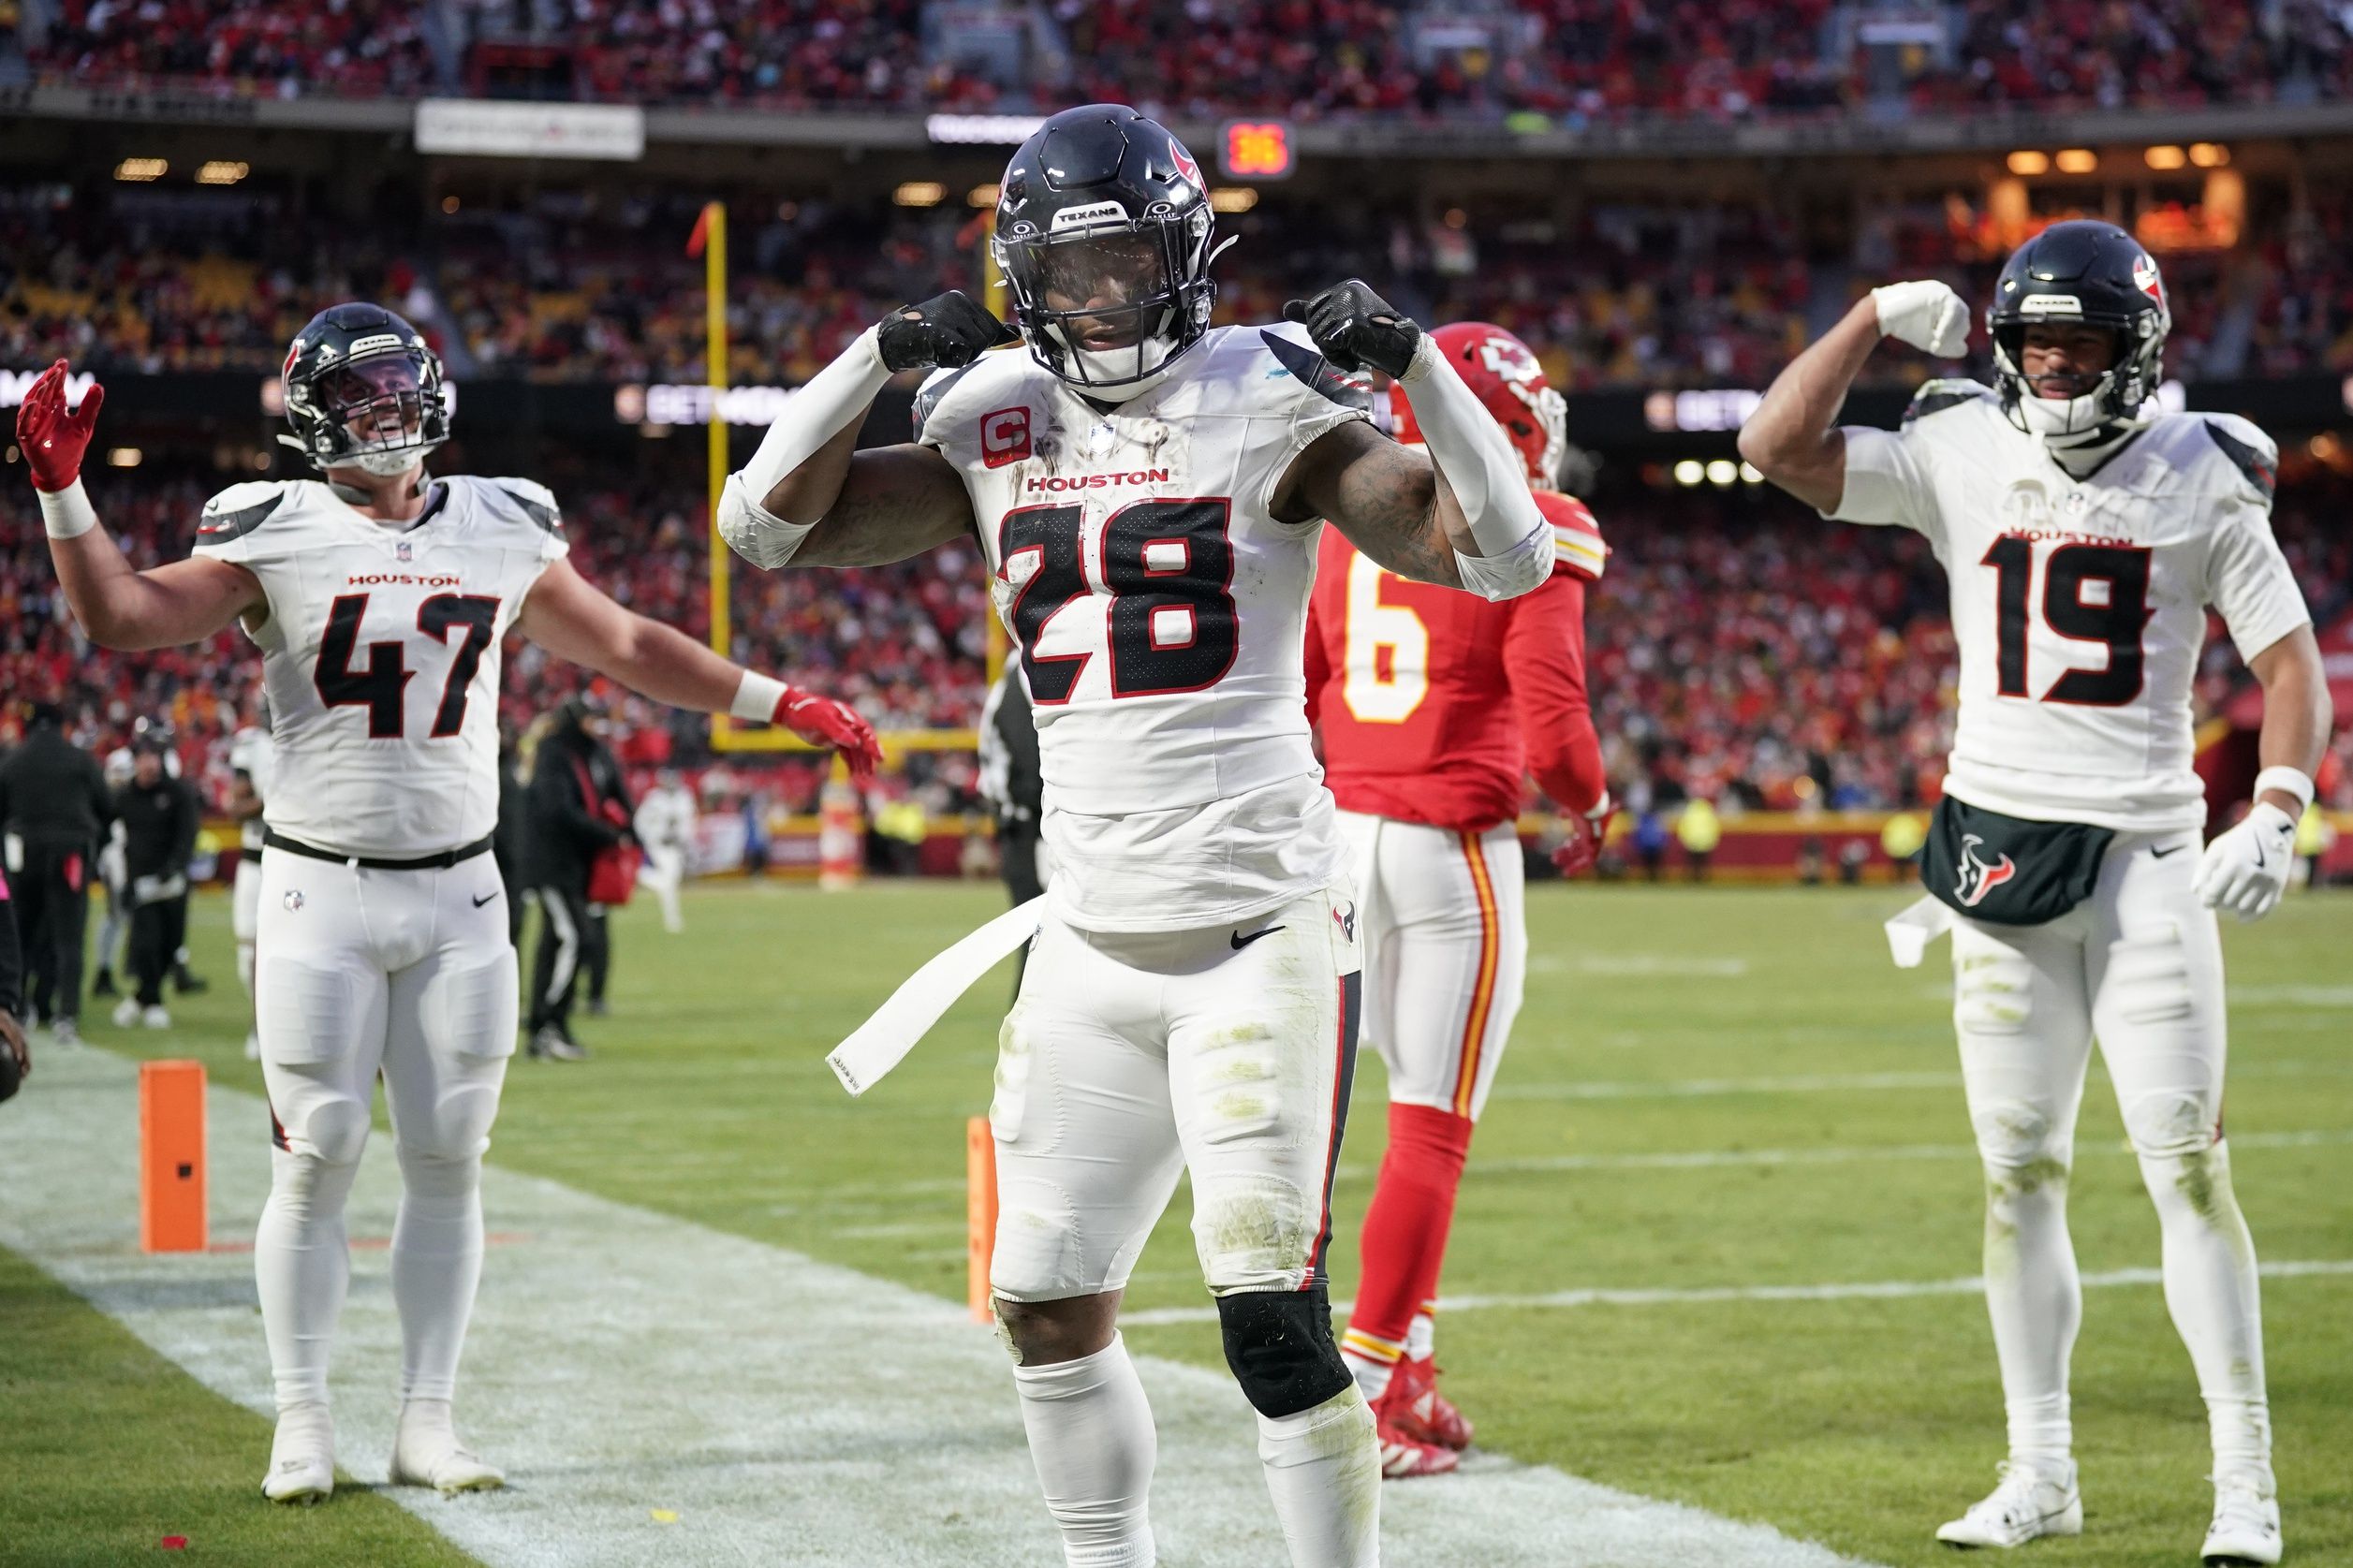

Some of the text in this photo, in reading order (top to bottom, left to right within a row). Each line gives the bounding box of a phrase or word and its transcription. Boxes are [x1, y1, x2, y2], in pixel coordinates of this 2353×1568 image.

[1059, 207, 1119, 223] TEXANS
[985, 410, 1026, 453] C
[1027, 468, 1169, 492] HOUSTON
[2010, 525, 2134, 547] HOUSTON
[348, 574, 461, 587] HOUSTON
[996, 496, 1240, 705] 28
[1343, 549, 1430, 725] 6
[1979, 531, 2157, 707] 19
[313, 593, 502, 739] 47
